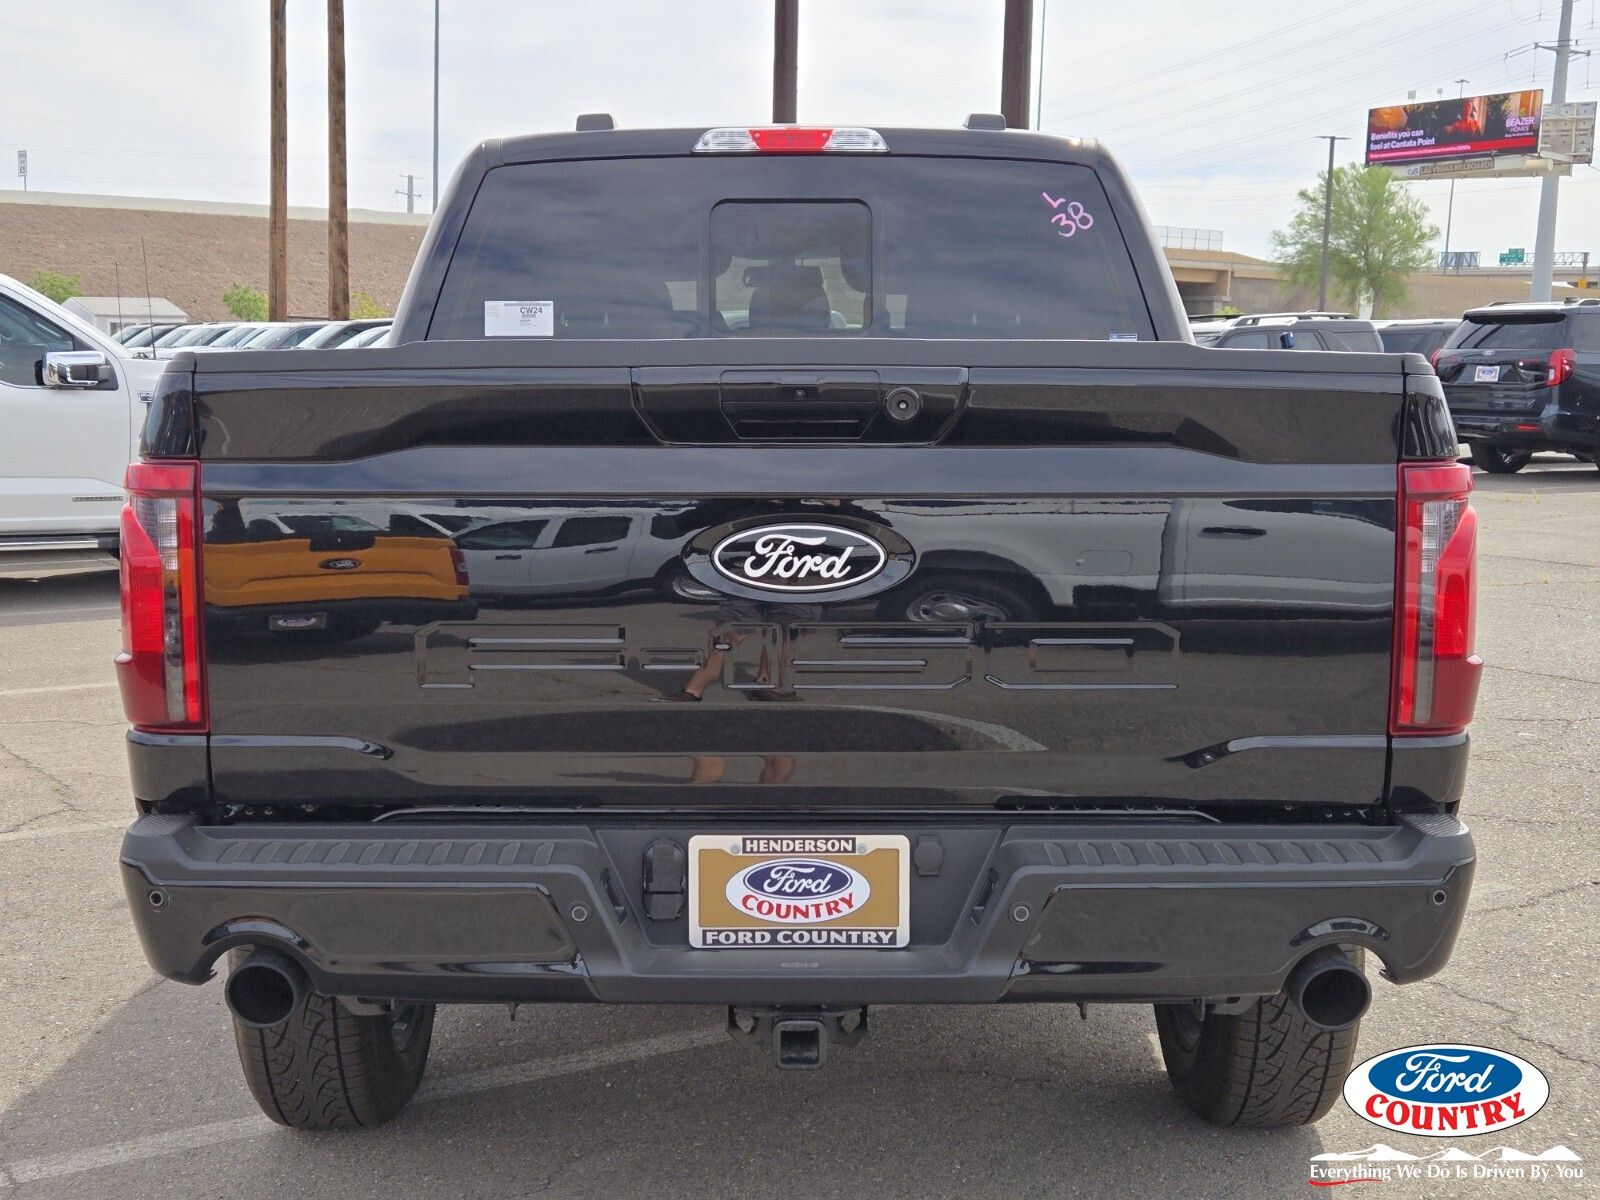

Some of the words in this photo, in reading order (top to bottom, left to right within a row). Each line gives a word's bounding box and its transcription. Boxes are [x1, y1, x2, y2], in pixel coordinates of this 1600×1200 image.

[1505, 116, 1535, 127] BEAZER
[1371, 131, 1398, 141] Benefits
[1398, 131, 1410, 139] you
[1411, 129, 1424, 137] can
[1383, 142, 1390, 150] at
[1417, 137, 1435, 146] Point
[1051, 201, 1094, 237] 38
[520, 306, 543, 314] CW24
[743, 534, 854, 579] Ford
[745, 839, 853, 852] HENDERSON
[763, 865, 832, 894] Ford
[741, 892, 855, 920] COUNTRY
[706, 930, 771, 945] FORD
[776, 930, 894, 945] COUNTRY
